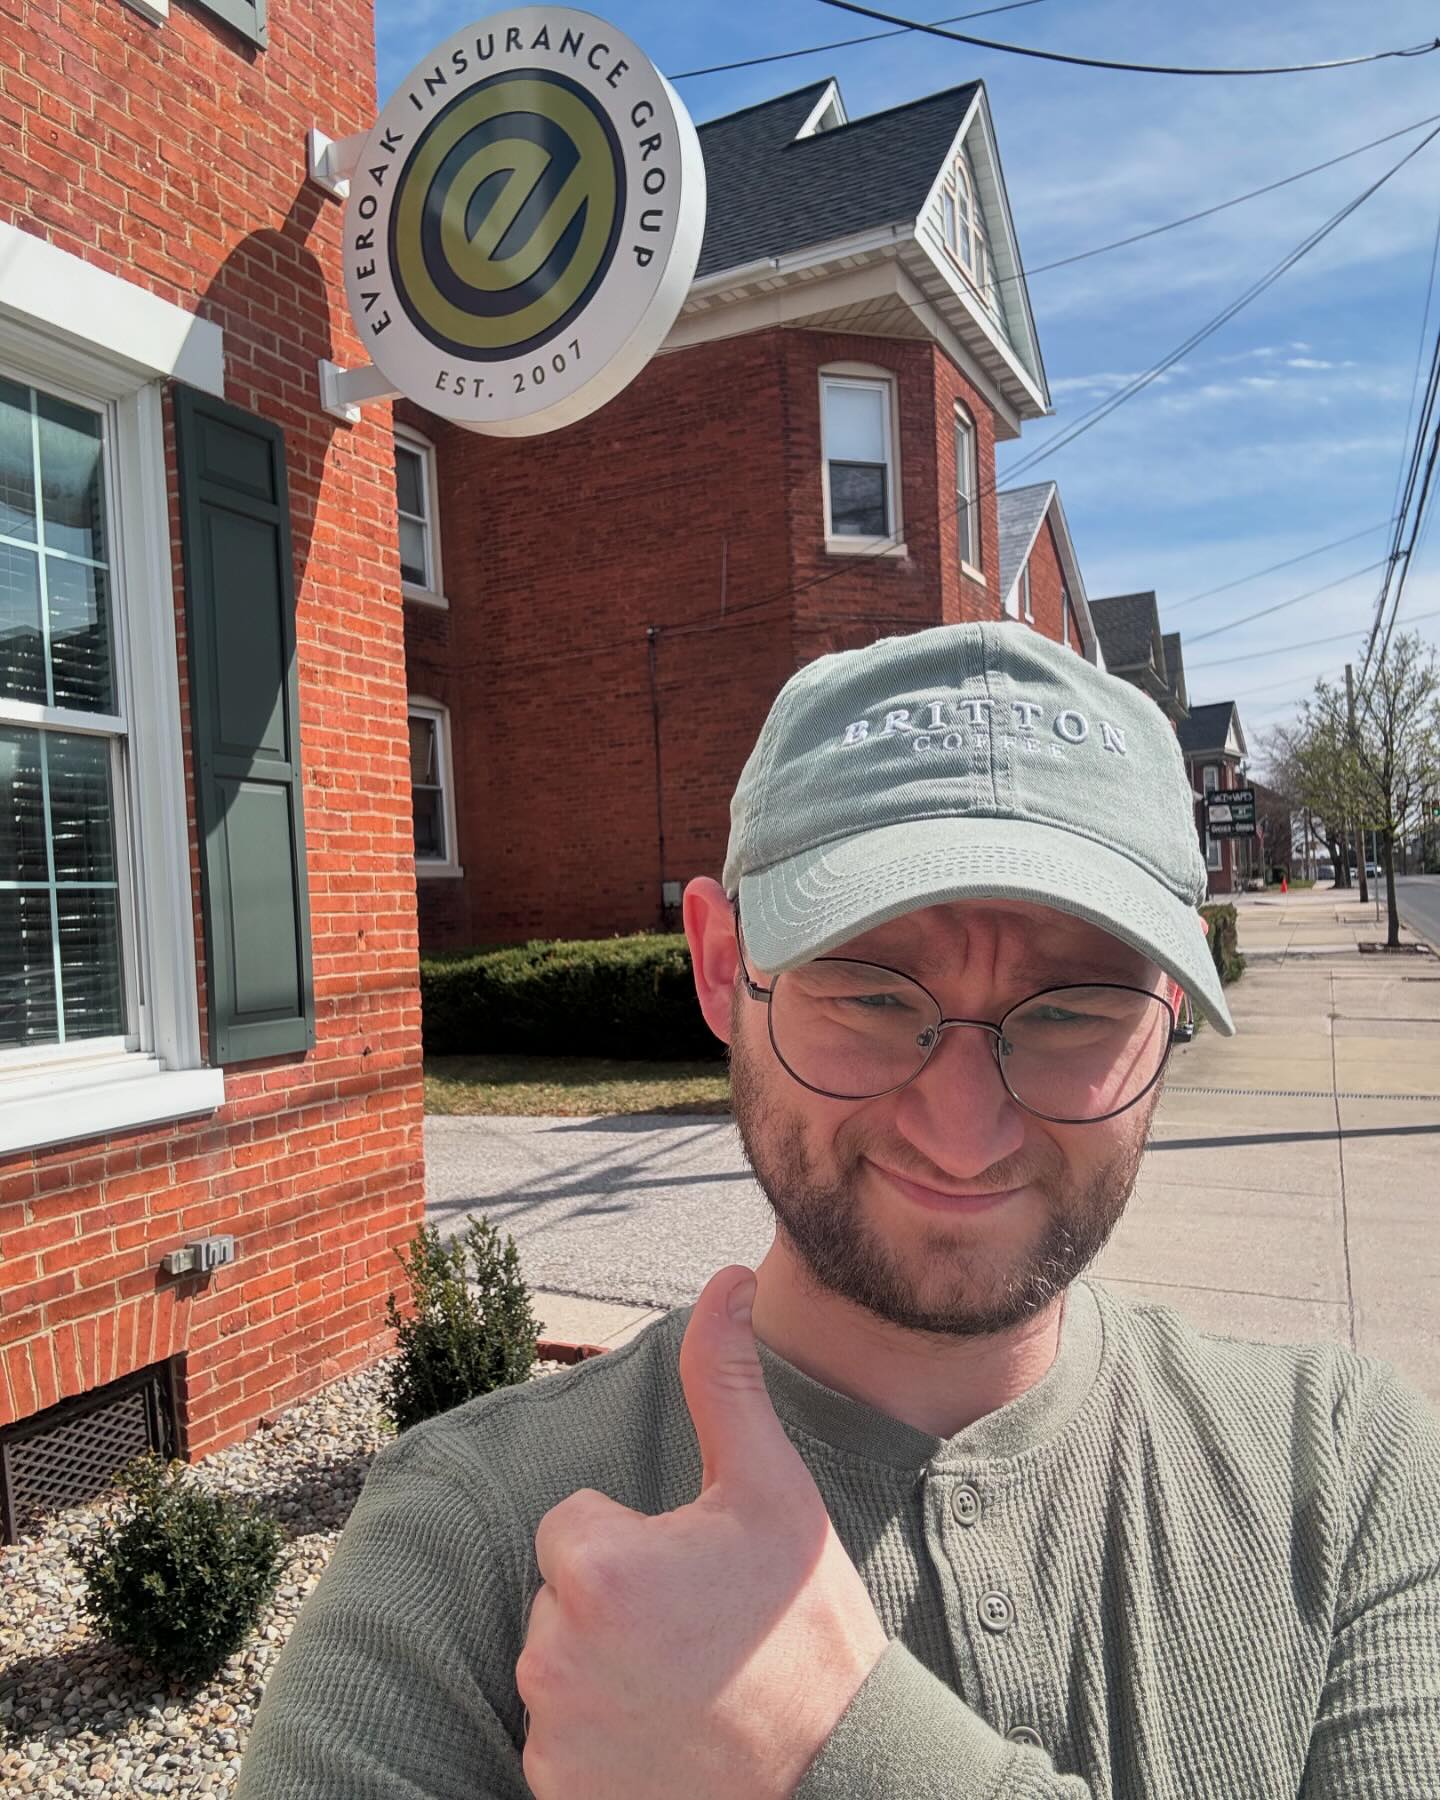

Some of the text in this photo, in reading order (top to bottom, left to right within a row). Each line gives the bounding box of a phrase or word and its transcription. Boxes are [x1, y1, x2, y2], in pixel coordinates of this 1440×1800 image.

[356, 24, 665, 336] EVEROAK INSURANCE GROUP
[435, 339, 583, 398] EST. 2007
[842, 699, 1127, 755] BRITTON
[912, 733, 1066, 760] COFFEE
